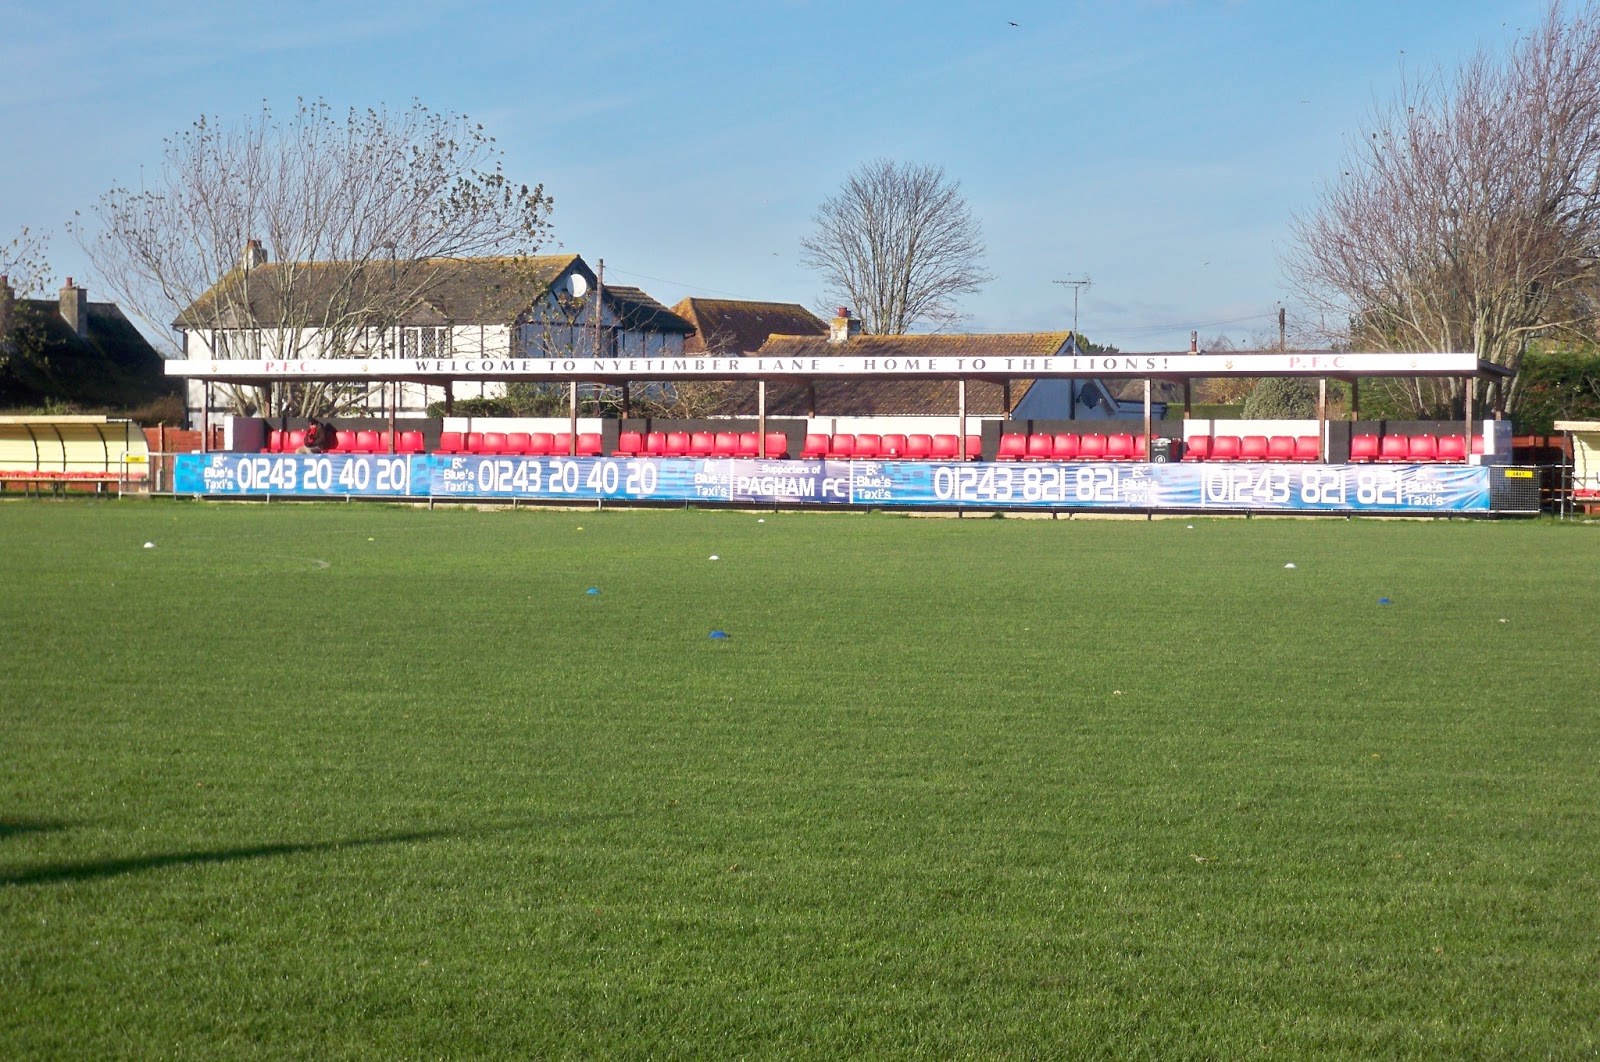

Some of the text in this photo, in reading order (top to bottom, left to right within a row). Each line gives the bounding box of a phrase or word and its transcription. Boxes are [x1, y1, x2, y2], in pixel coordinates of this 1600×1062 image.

[416, 360, 531, 372] WELCOME
[548, 360, 576, 371] TO
[593, 359, 739, 371] NYETIMBER
[758, 359, 820, 370] LANE
[864, 359, 938, 370] HOME
[956, 358, 986, 370] TO
[1005, 358, 1053, 370] THE
[1073, 358, 1169, 370] LIONS!
[204, 467, 233, 478] Blue's
[237, 458, 406, 490] 01243 20 40 20
[443, 469, 475, 480] Blue's
[761, 464, 821, 475] Supporters of
[478, 460, 657, 494] 01243 20 40 20
[857, 476, 891, 487] Blue's
[204, 479, 233, 489] Taxi's
[443, 481, 474, 491] Taxi's
[737, 477, 846, 497] PAGHAM FC
[934, 466, 1119, 502] 01243 821 821
[1207, 468, 1402, 505] 01243 821 821
[695, 485, 728, 496] Taxi's
[857, 488, 891, 499] Taxi's
[1406, 493, 1444, 506] Taxi's
